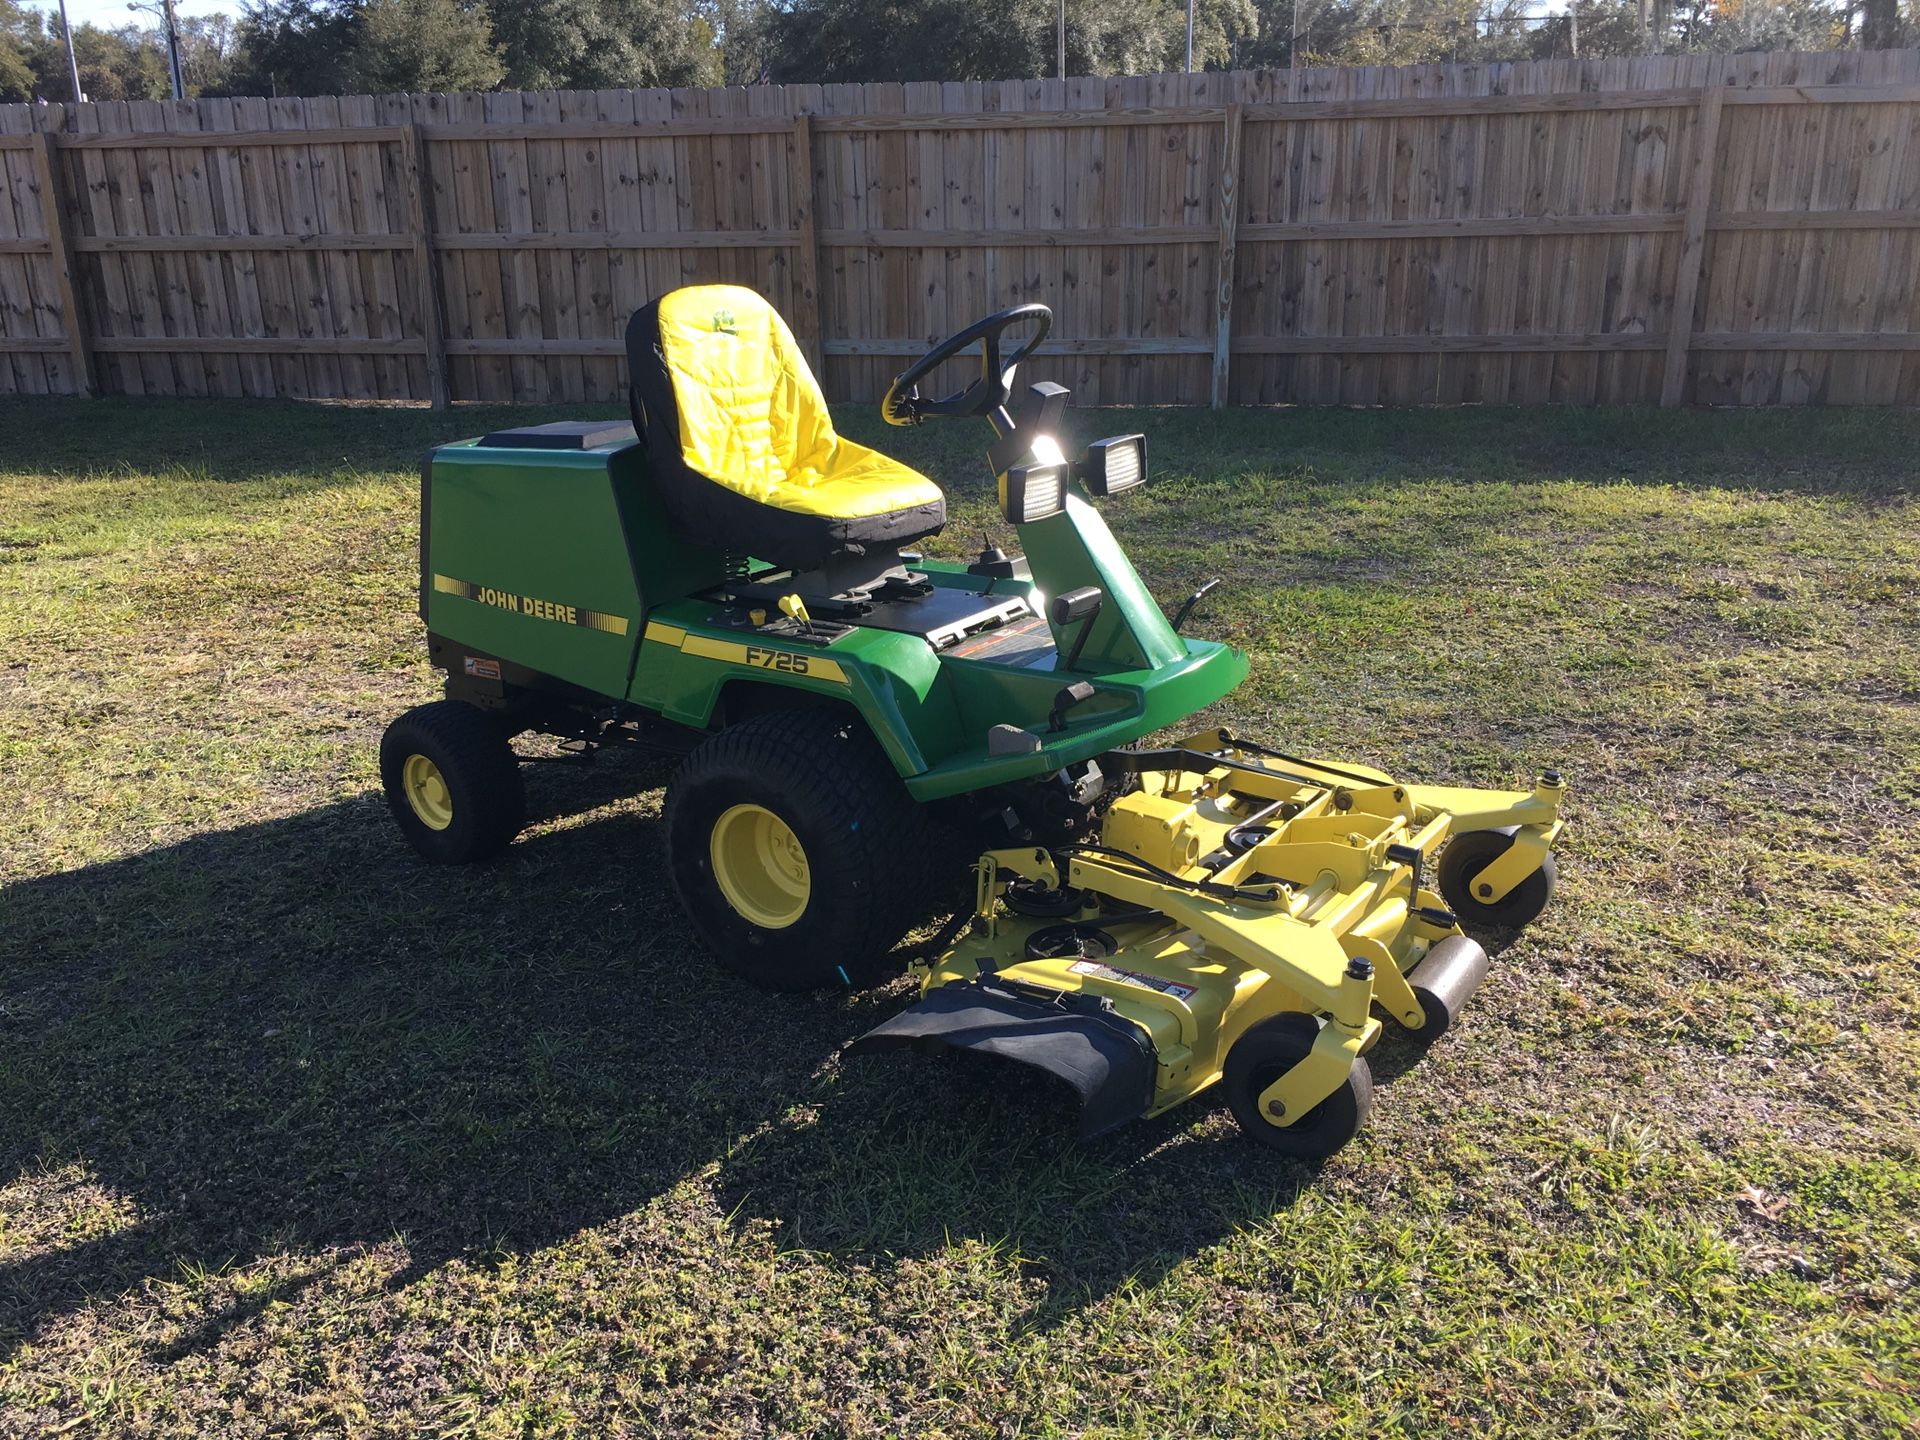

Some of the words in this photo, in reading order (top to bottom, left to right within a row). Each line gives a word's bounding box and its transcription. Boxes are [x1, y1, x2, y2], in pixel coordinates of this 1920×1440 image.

[478, 587, 518, 612] JOHN
[523, 597, 577, 625] DEERE
[746, 646, 809, 674] F725
